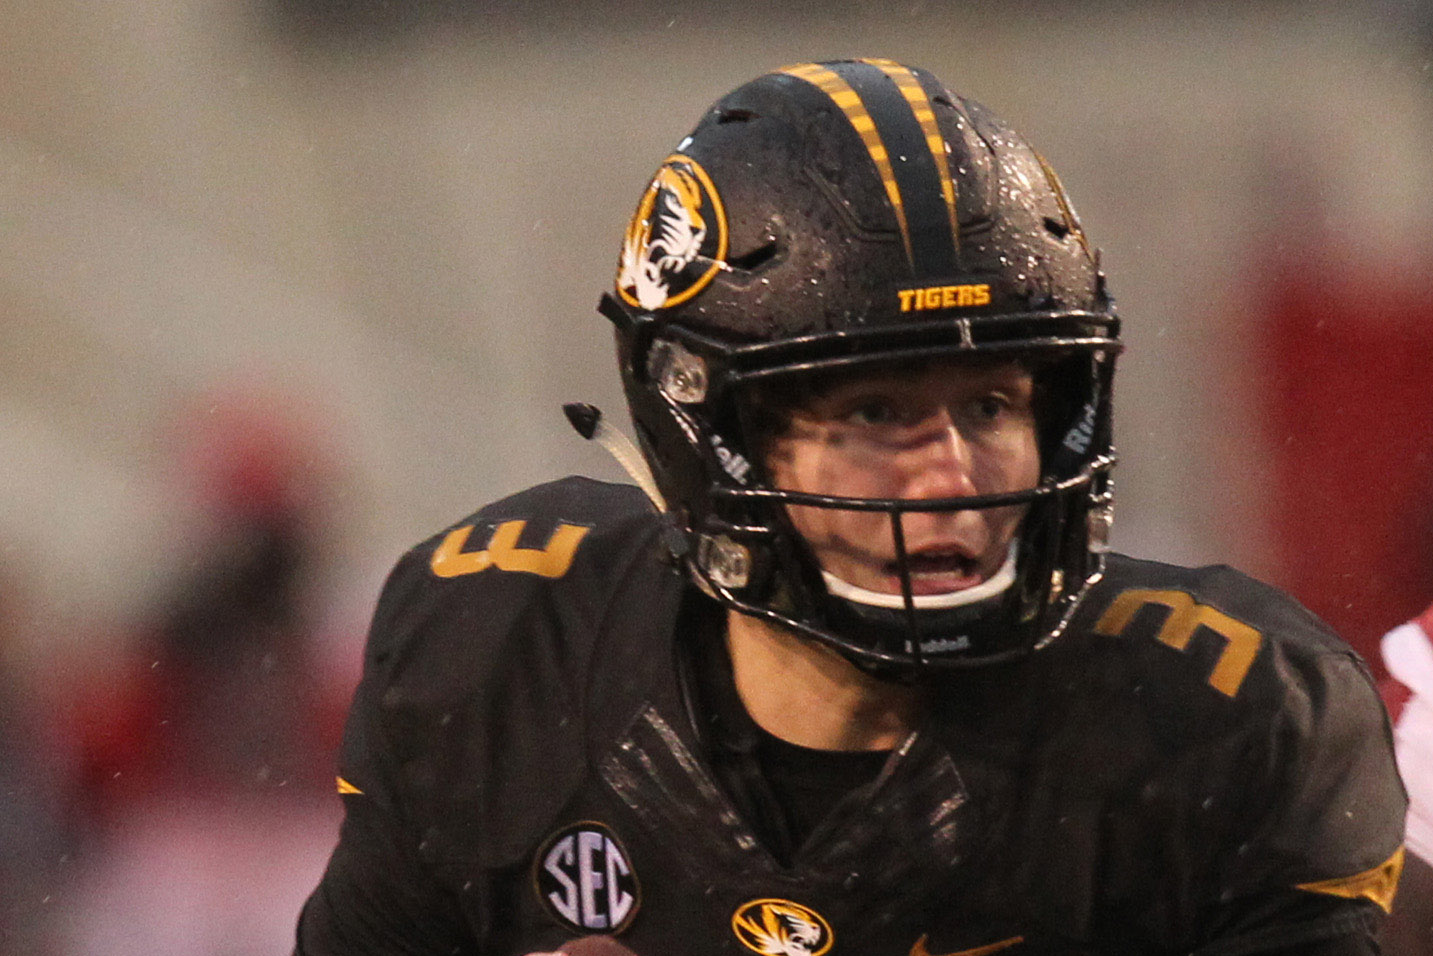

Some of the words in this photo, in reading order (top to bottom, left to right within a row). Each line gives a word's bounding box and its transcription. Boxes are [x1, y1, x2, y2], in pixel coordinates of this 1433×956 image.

[898, 283, 991, 312] TIGERS
[430, 520, 592, 578] 3
[1093, 589, 1263, 698] 3
[543, 831, 634, 930] SEC
